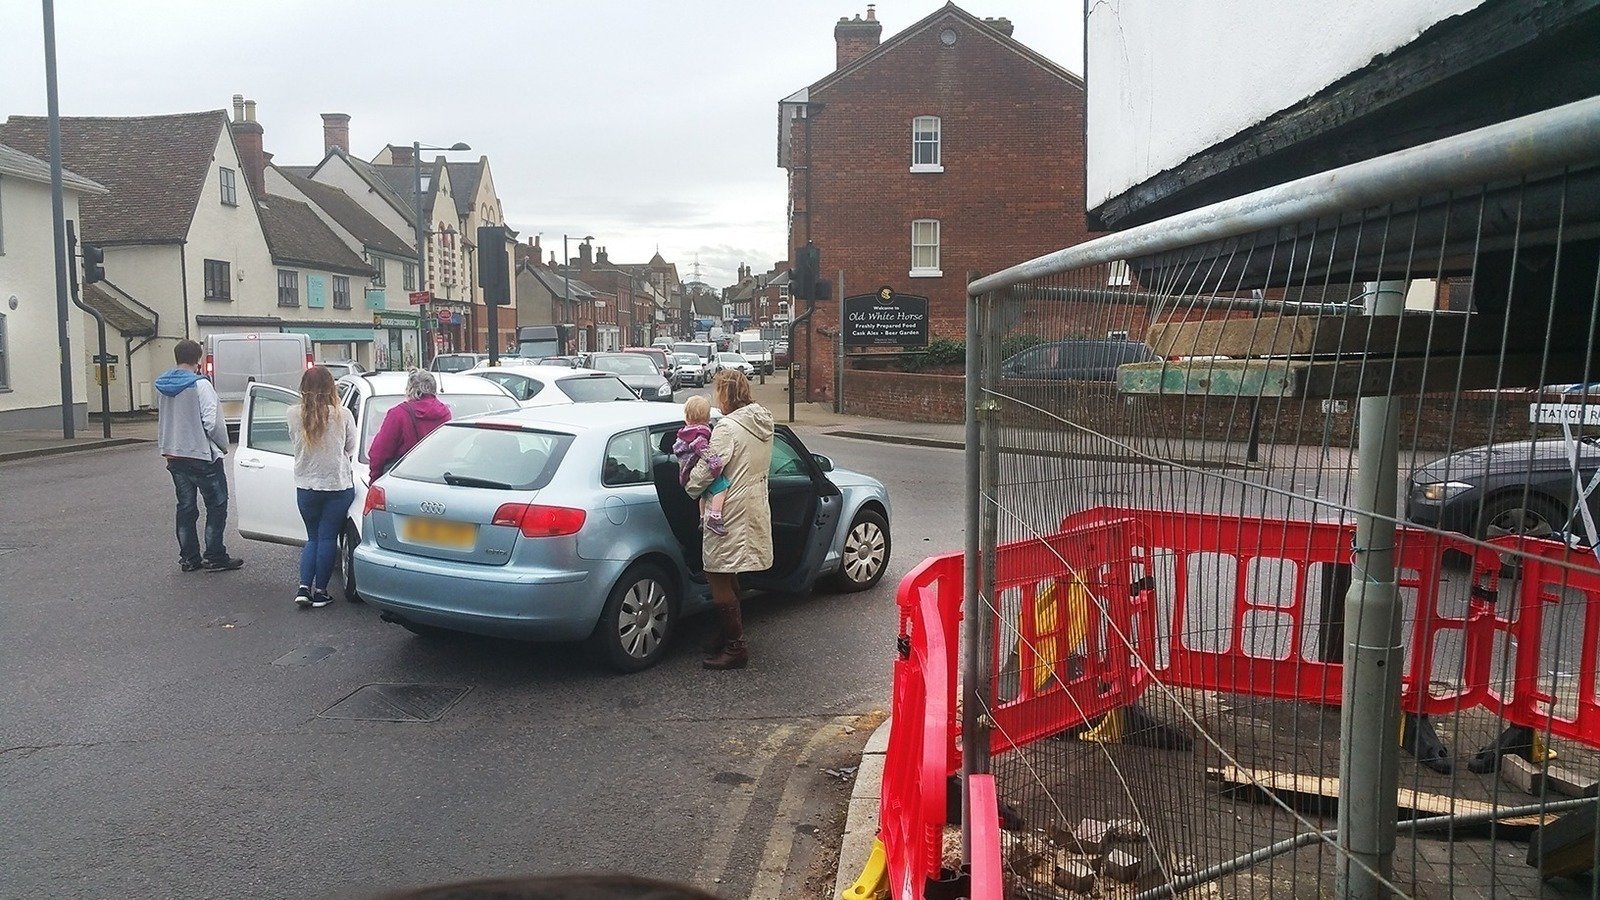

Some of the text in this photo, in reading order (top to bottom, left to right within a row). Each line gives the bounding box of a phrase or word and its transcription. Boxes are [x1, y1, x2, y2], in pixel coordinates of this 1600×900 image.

[849, 311, 923, 321] Old White Horse
[1591, 410, 1600, 420] R
